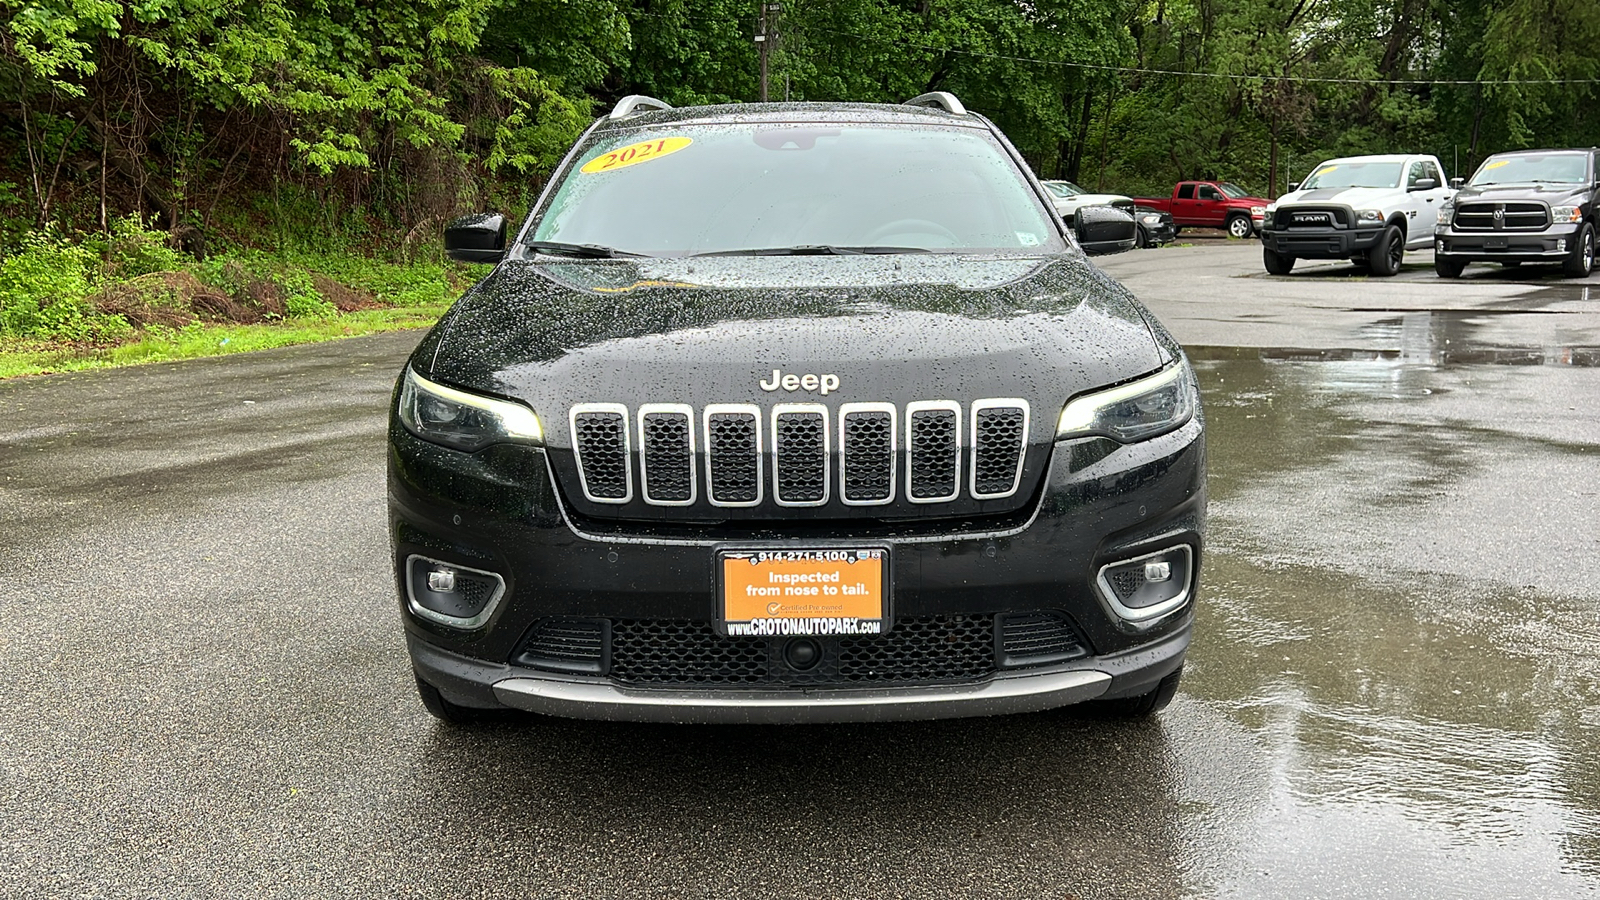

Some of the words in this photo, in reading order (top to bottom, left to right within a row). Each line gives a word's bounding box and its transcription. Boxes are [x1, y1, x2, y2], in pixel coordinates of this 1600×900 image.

[602, 140, 665, 169] 2021
[759, 369, 840, 395] Jeep
[758, 551, 848, 562] 914-271-5100
[769, 571, 840, 585] Inspected
[746, 585, 781, 596] from
[785, 586, 819, 596] nose
[823, 585, 838, 596] to
[842, 583, 870, 596] tail.
